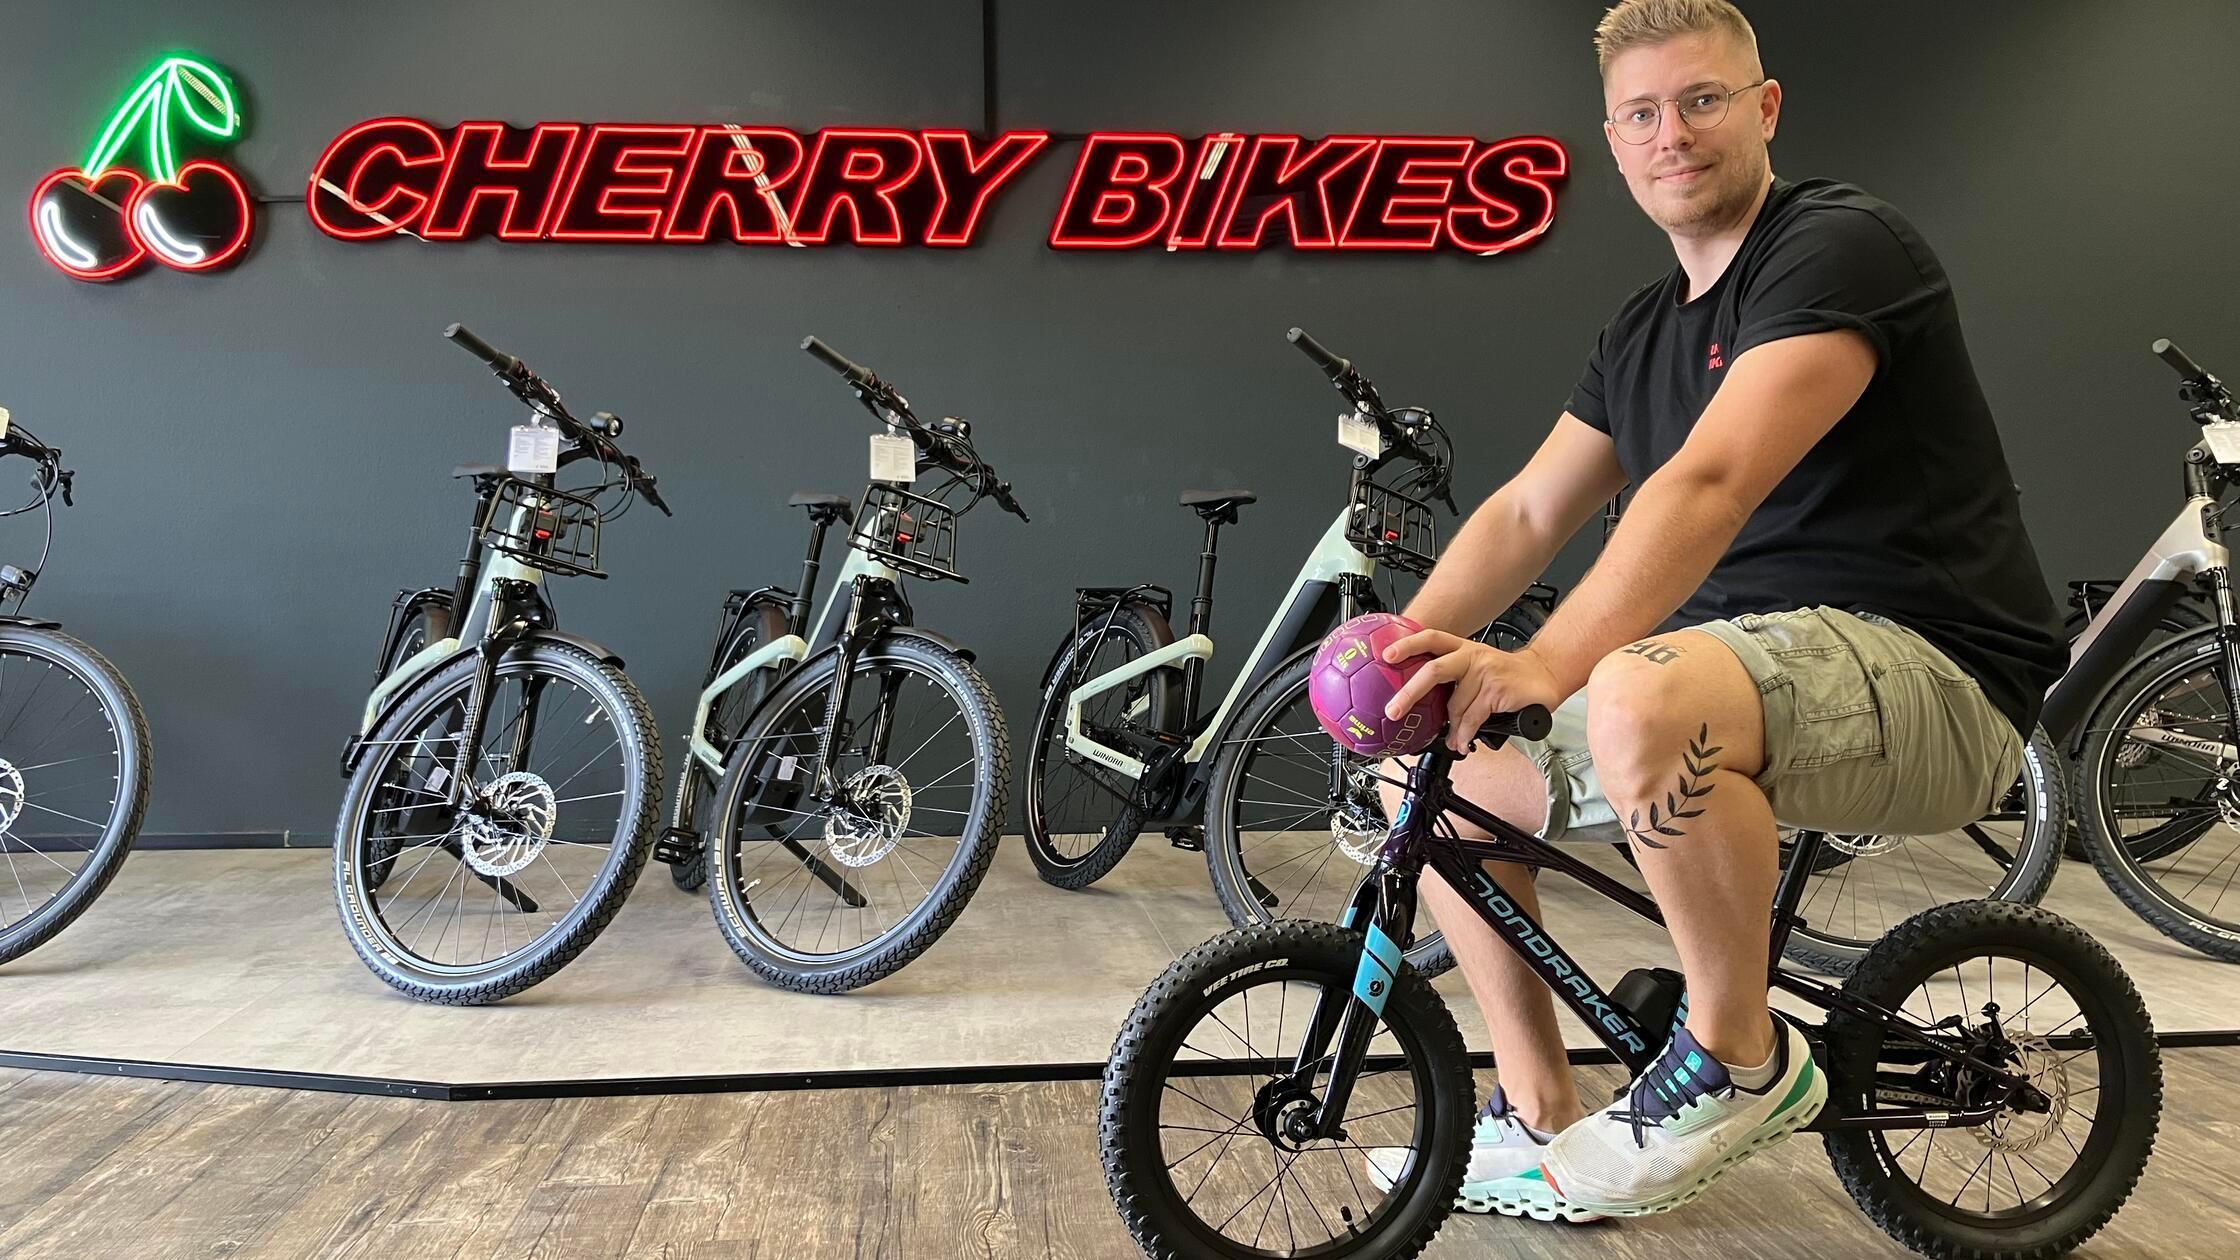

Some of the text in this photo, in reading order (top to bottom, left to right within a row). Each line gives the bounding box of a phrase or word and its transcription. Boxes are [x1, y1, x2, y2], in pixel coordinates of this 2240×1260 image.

[307, 117, 1569, 255] CHERRY BIKES
[343, 860, 383, 953] AL GROUNDER
[714, 837, 749, 938] SCHWALBE
[1202, 975, 1229, 998] VEE
[1229, 962, 1264, 981] TIRE
